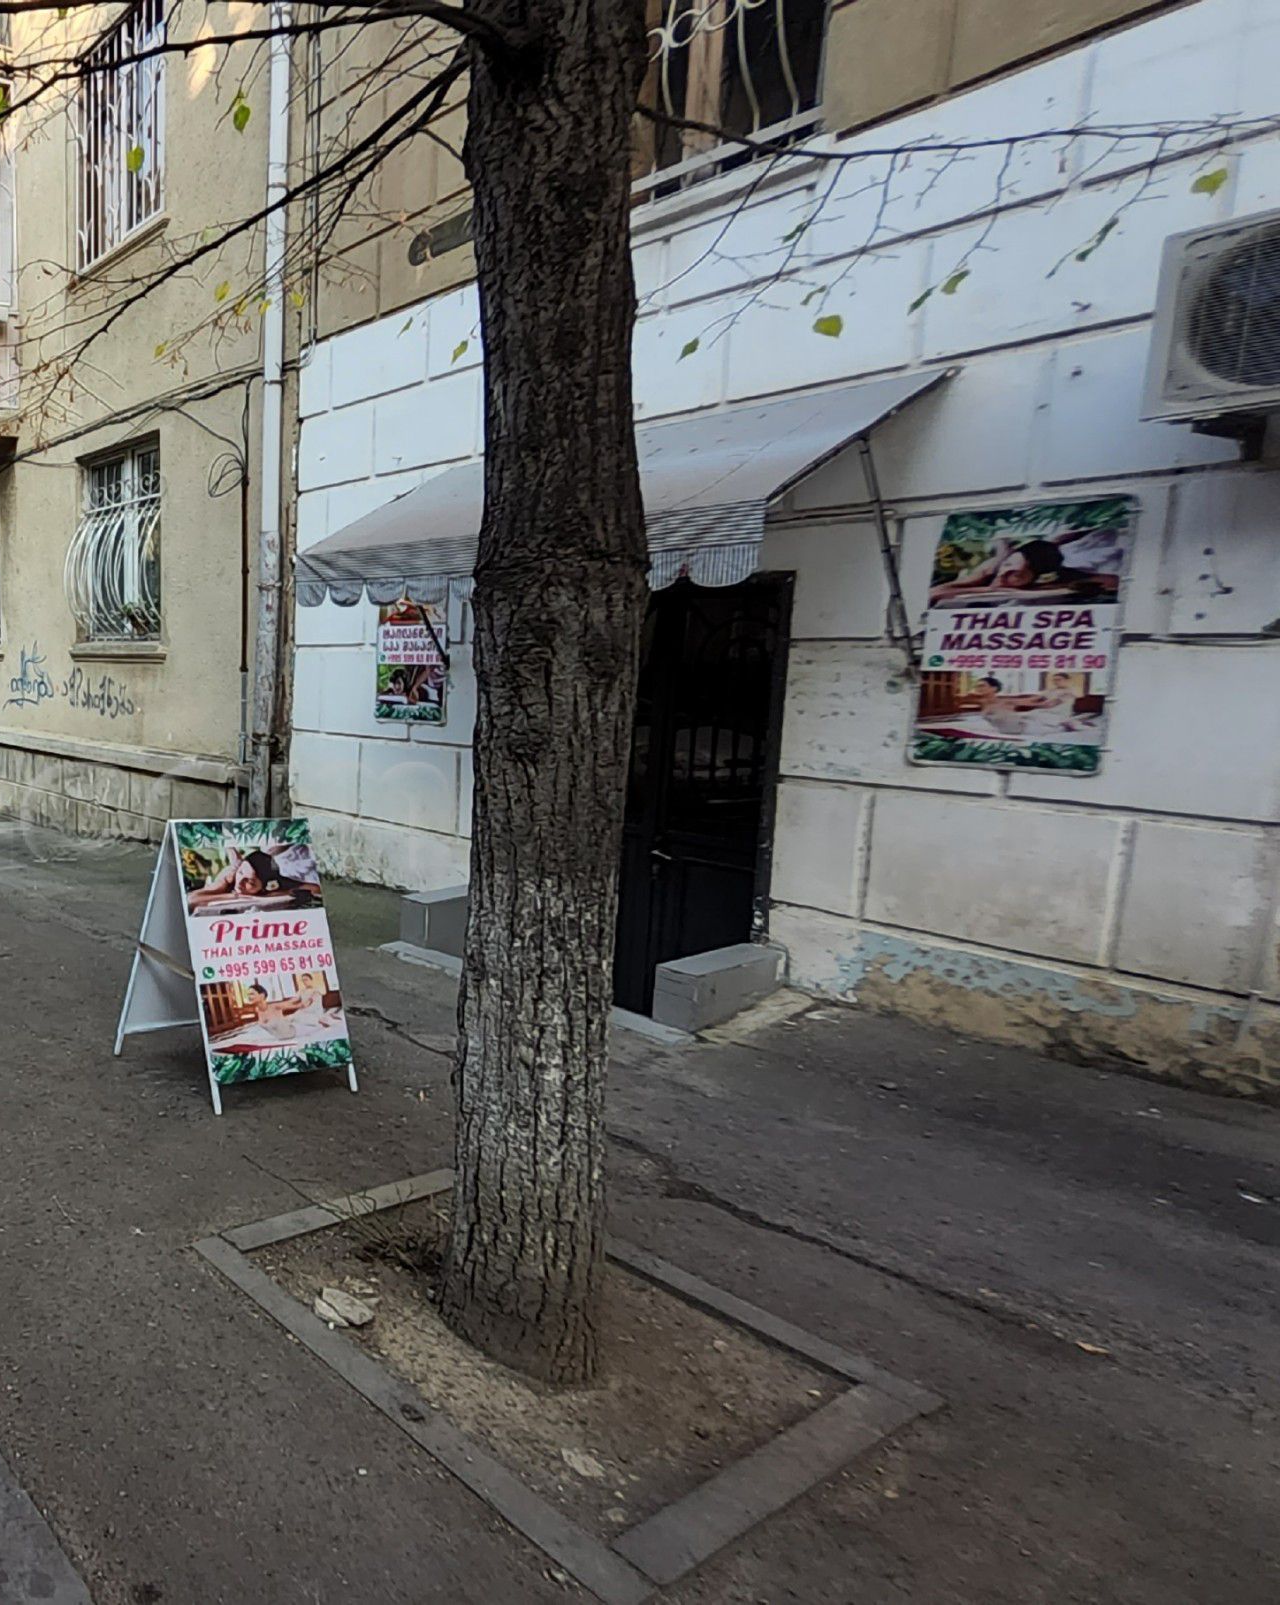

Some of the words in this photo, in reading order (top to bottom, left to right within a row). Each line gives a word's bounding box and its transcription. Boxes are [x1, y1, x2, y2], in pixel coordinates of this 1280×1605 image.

[951, 612, 1024, 630] THAI
[1032, 610, 1095, 629] SPA
[940, 632, 1097, 650] MASSAGE
[948, 655, 988, 668] +995
[991, 655, 1023, 668] 599
[1082, 654, 1107, 669] 90
[209, 919, 308, 943] Prime
[202, 947, 232, 959] THAI
[237, 944, 261, 955] SPA
[265, 938, 324, 952] MASSAGE
[218, 962, 249, 977] +995
[253, 959, 276, 974] 599
[280, 957, 295, 972] 65
[299, 955, 313, 970] 81
[317, 953, 333, 967] 90
